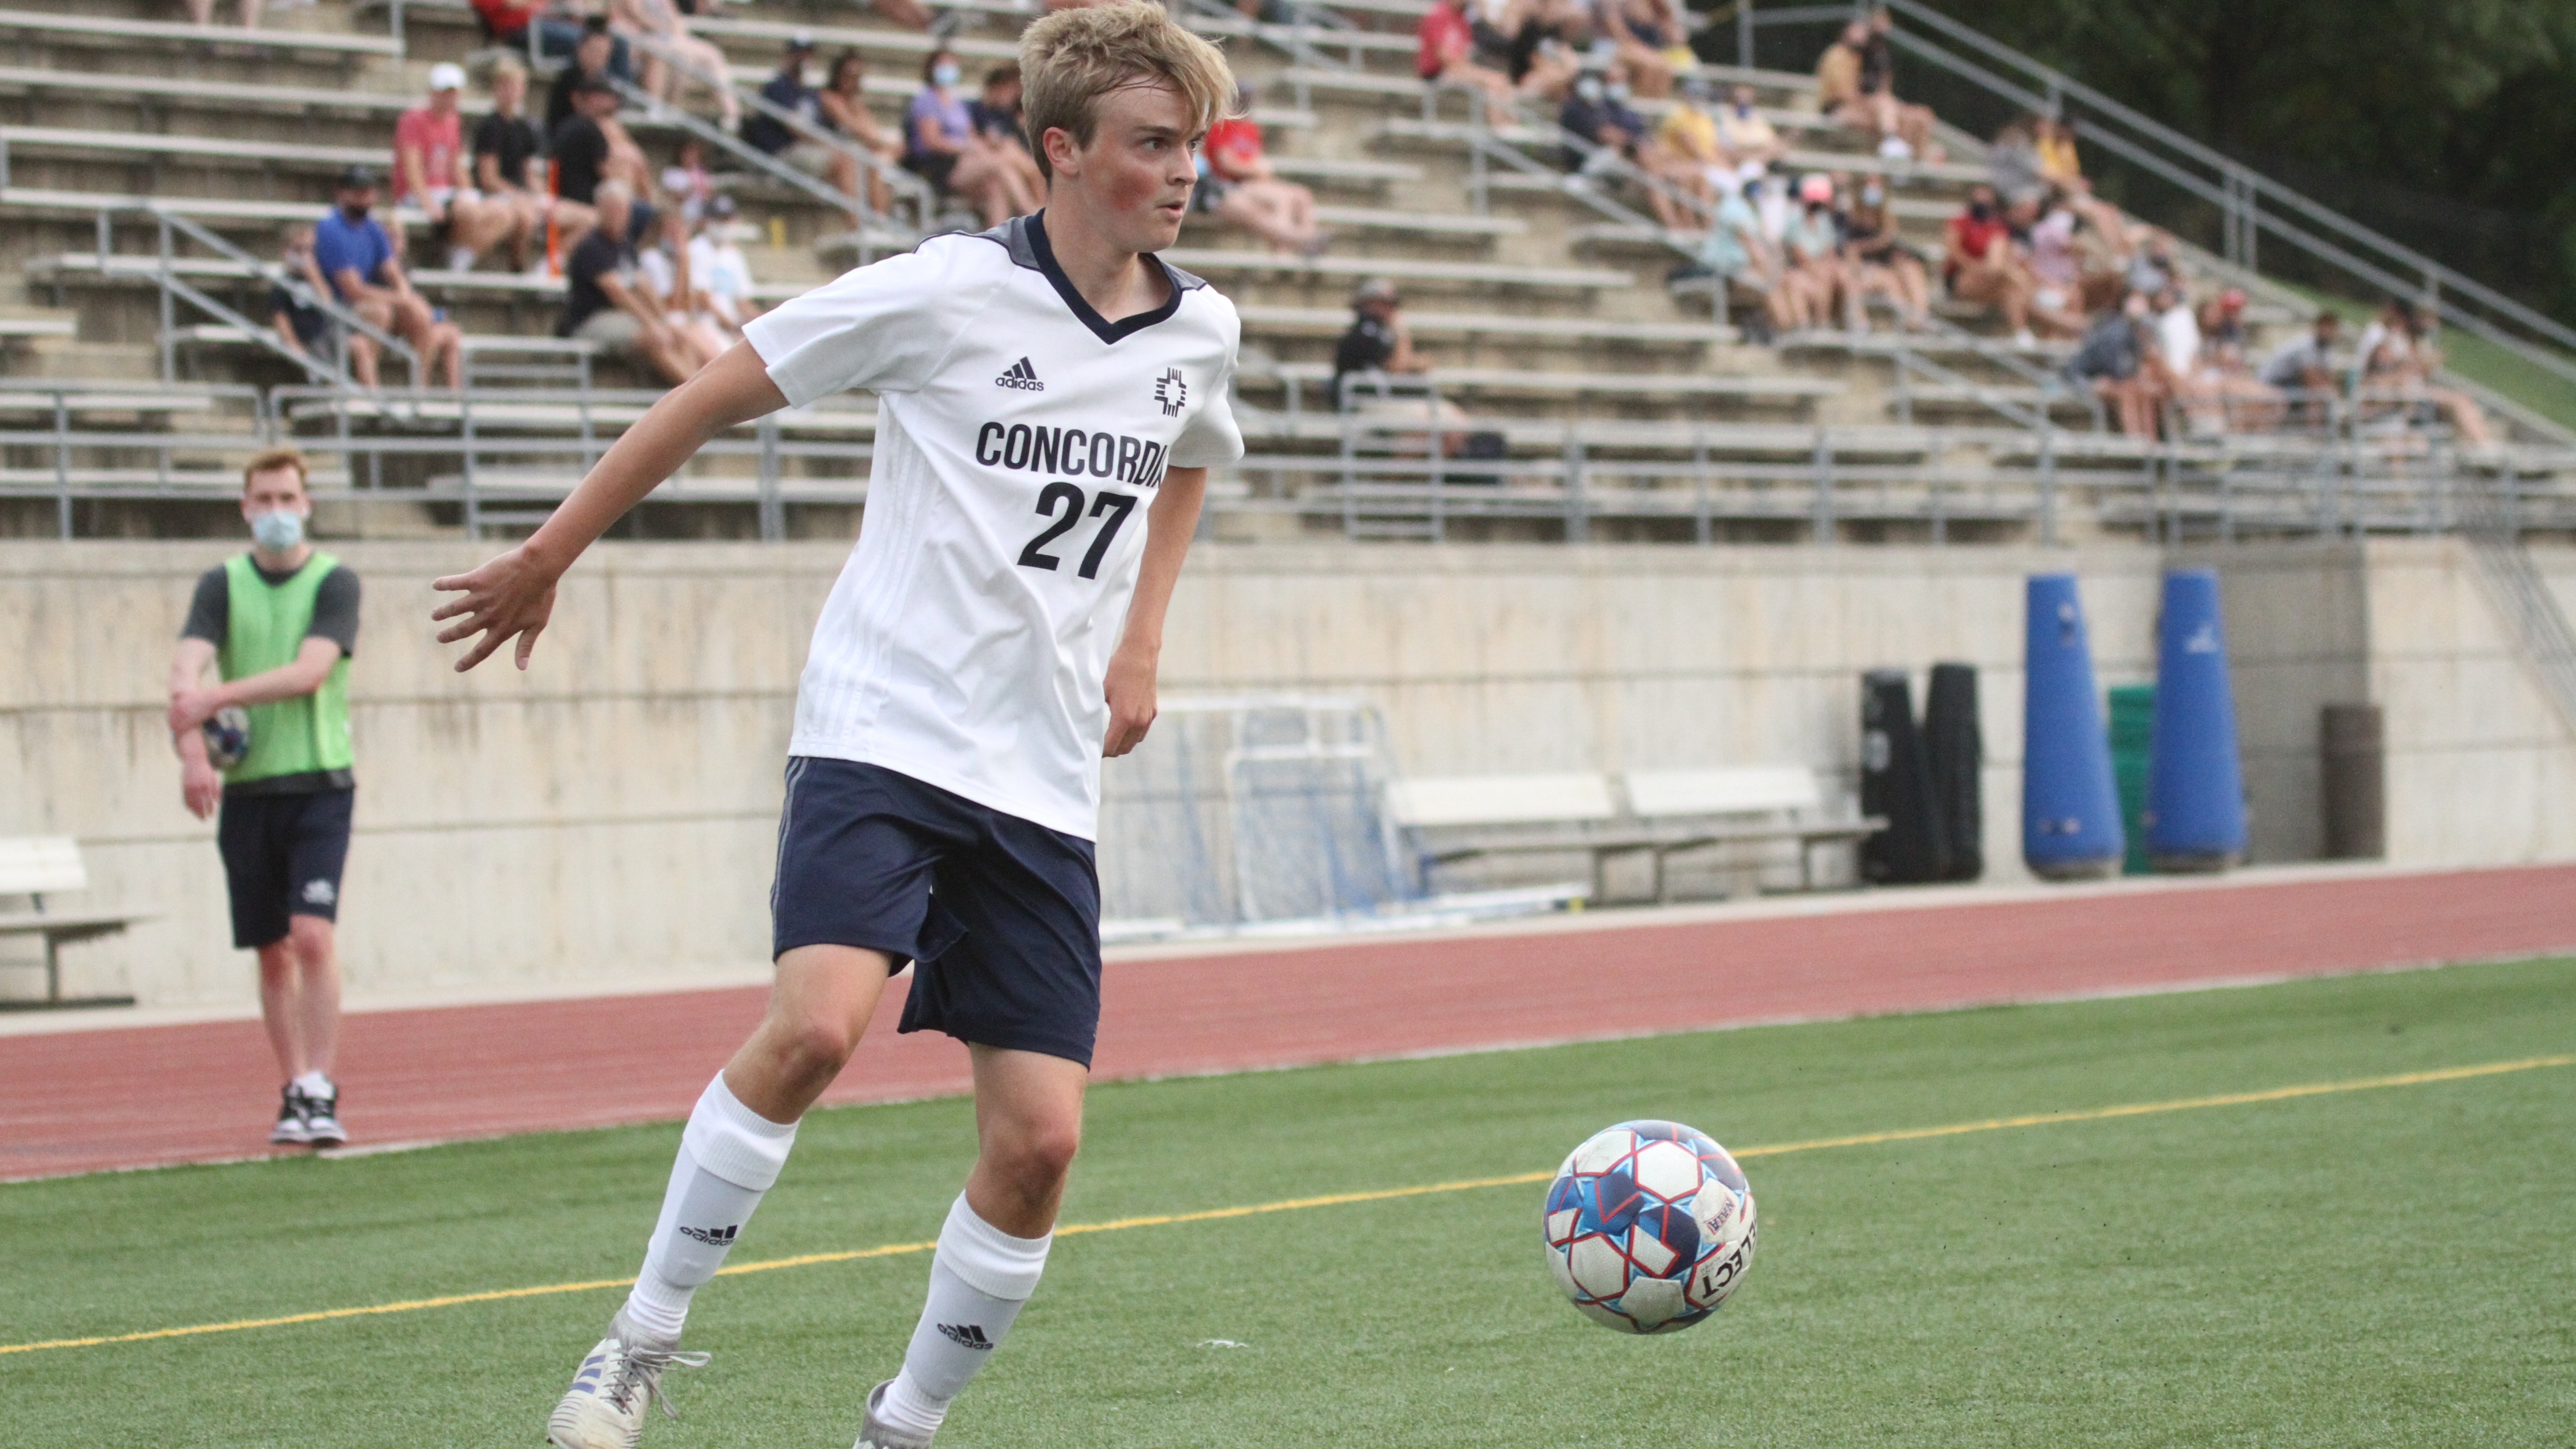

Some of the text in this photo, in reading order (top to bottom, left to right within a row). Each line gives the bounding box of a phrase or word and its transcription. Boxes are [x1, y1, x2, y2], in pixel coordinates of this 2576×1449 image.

[995, 376, 1044, 391] adidas
[1017, 482, 1137, 580] 27
[937, 1324, 993, 1350] adidas
